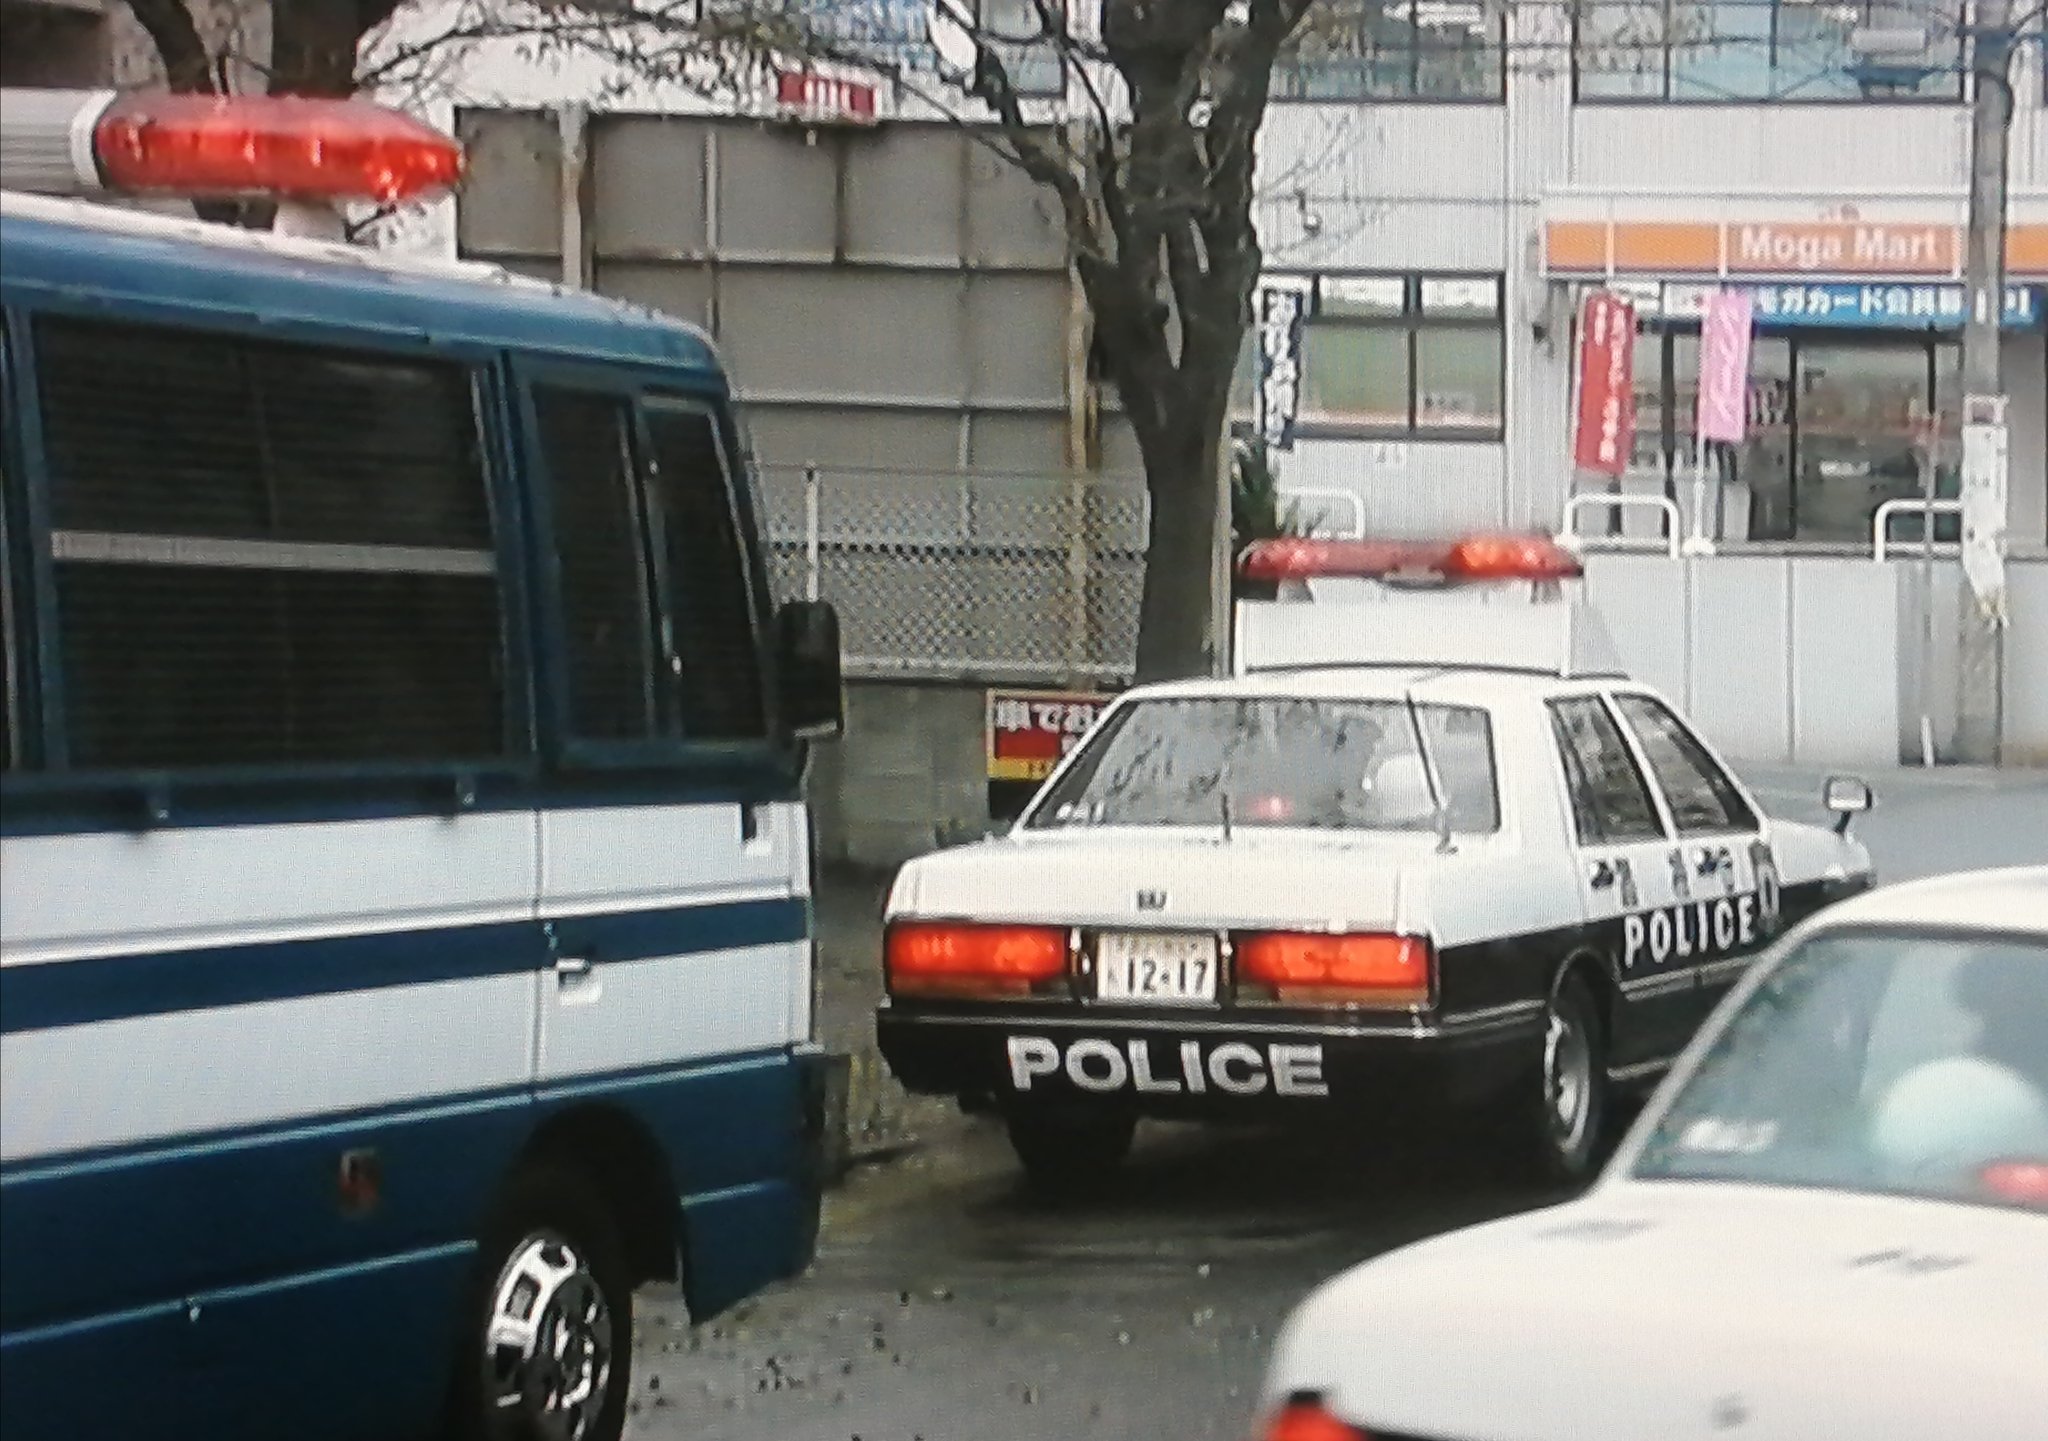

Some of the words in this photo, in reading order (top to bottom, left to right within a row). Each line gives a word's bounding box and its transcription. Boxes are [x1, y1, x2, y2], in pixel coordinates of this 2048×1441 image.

[1741, 226, 1843, 268] Moga
[1853, 226, 1938, 262] Mart
[1624, 893, 1753, 968] POLICE
[1008, 1035, 1329, 1096] POLICE
